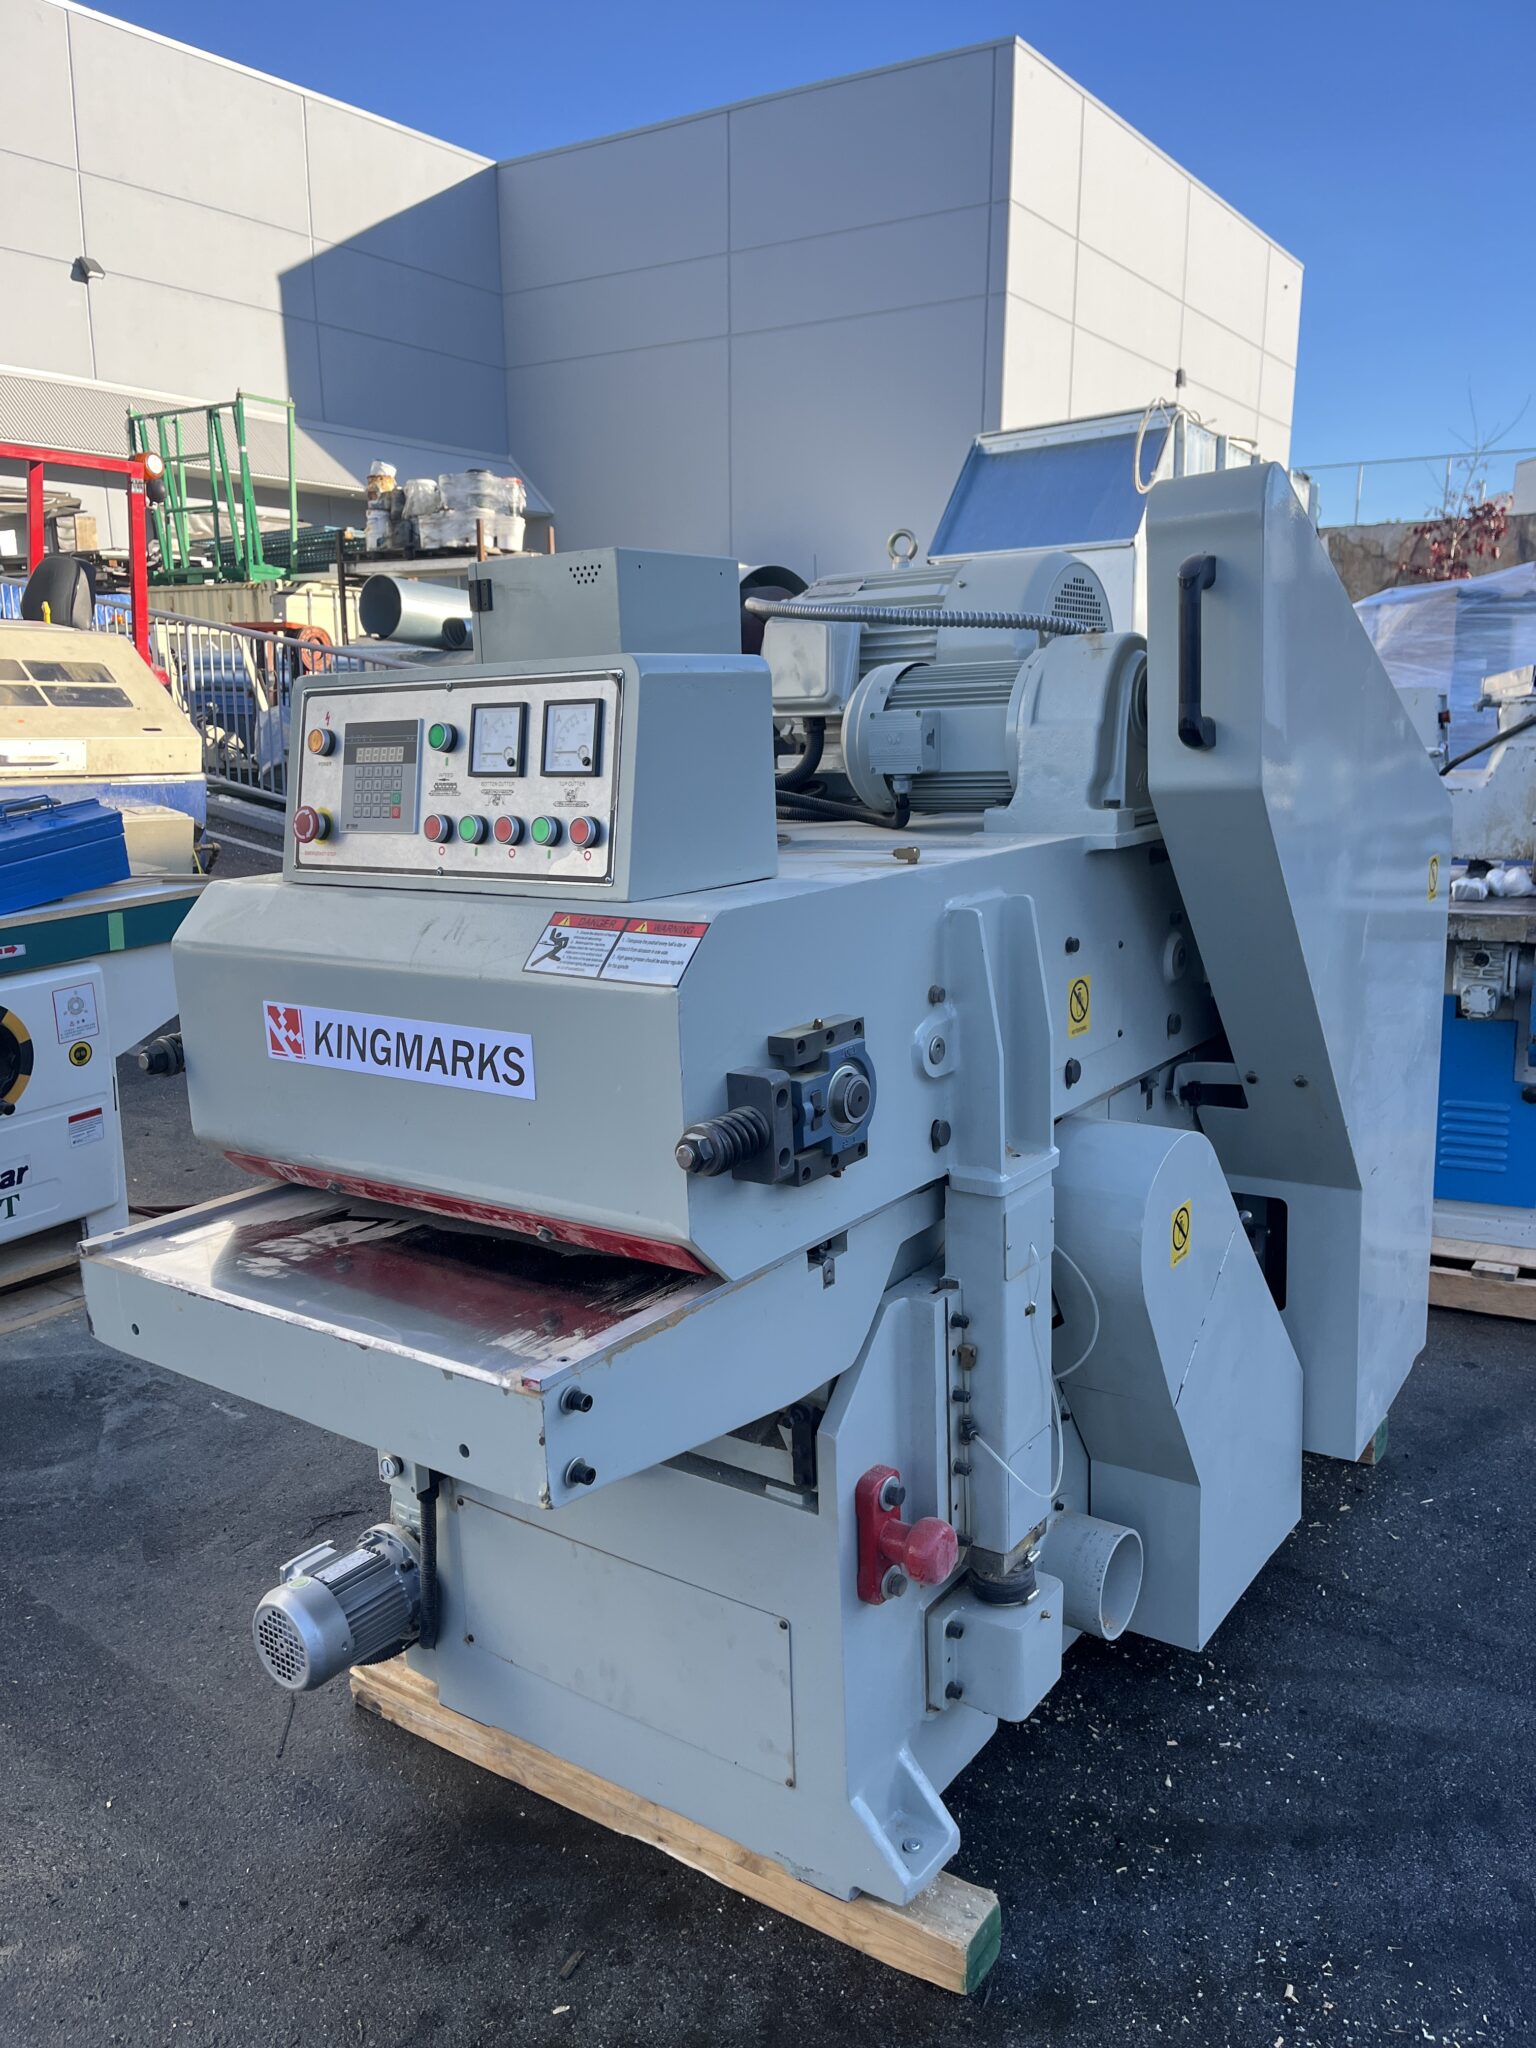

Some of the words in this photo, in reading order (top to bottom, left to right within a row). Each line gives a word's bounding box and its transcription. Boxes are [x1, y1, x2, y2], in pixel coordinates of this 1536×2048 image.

[577, 917, 617, 929] DANGER
[653, 924, 695, 935] WARNING
[314, 1020, 526, 1087] KINGMARKS
